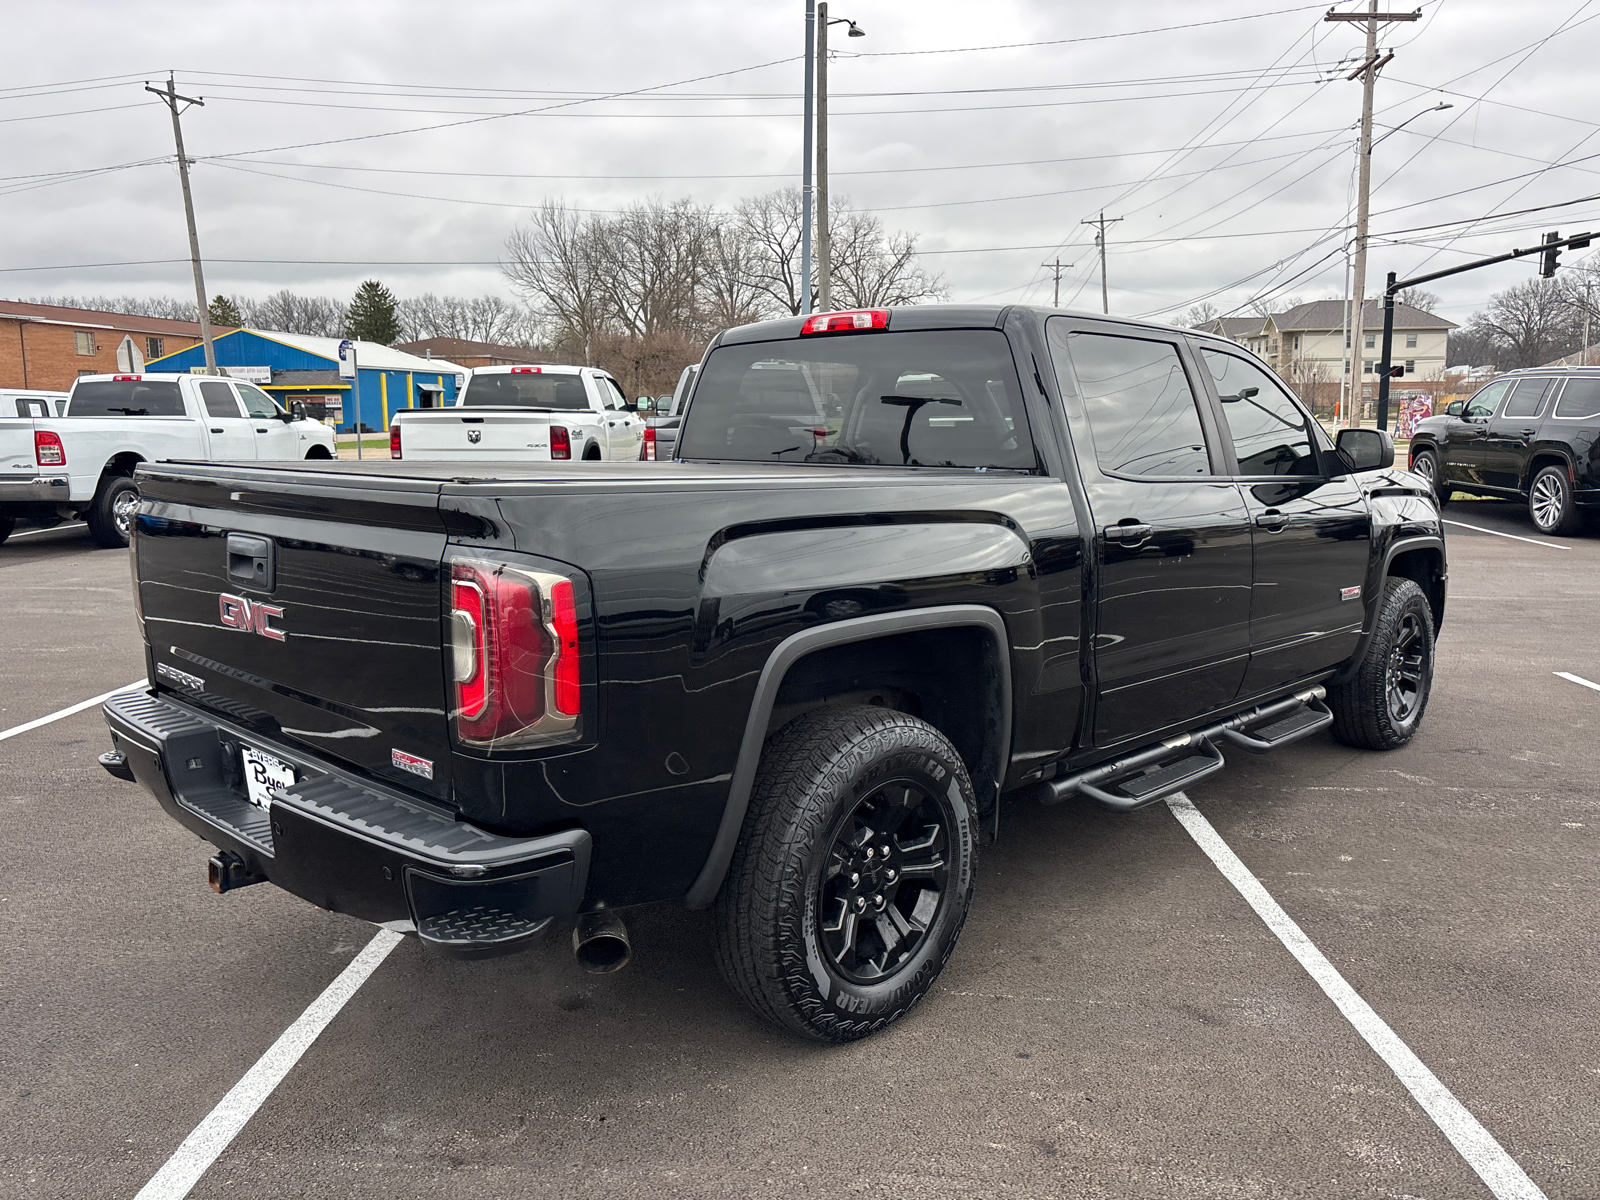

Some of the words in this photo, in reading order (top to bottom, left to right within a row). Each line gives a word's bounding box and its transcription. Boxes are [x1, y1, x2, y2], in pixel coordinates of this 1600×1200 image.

[219, 592, 287, 642] GMC
[157, 662, 206, 693] SIERRA
[252, 750, 281, 768] BYERS
[960, 818, 970, 885] TERRITORY
